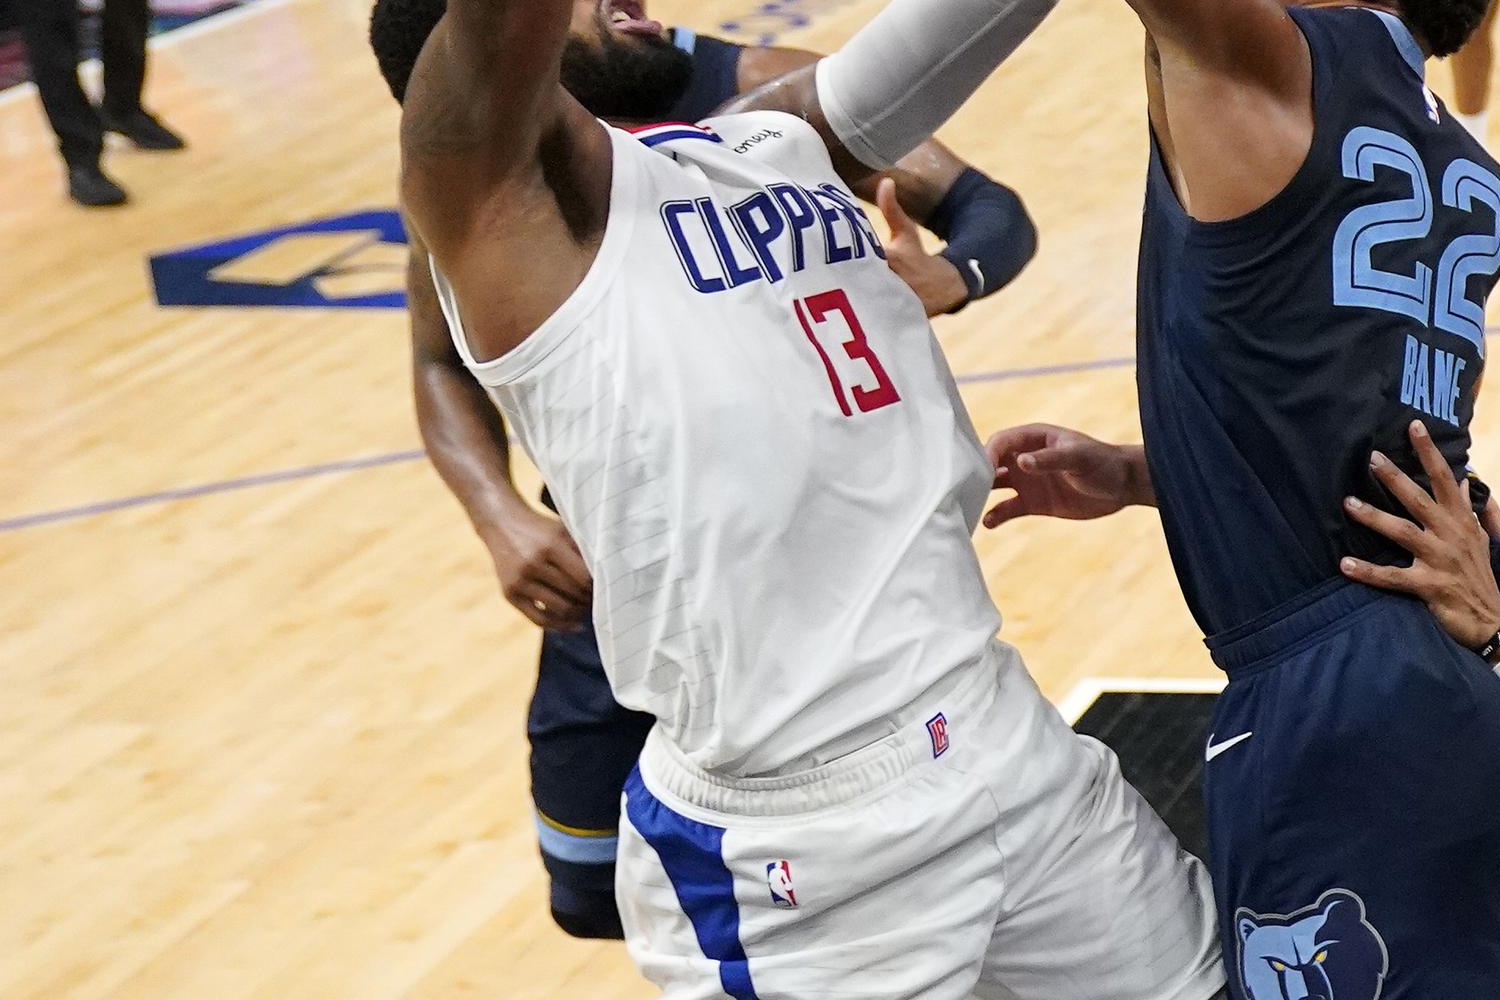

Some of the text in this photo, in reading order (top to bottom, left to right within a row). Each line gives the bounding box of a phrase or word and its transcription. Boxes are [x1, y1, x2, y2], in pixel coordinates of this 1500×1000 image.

[733, 127, 783, 155] oney
[659, 182, 888, 294] CLPPER
[793, 288, 901, 417] 13
[1400, 334, 1467, 427] BANE
